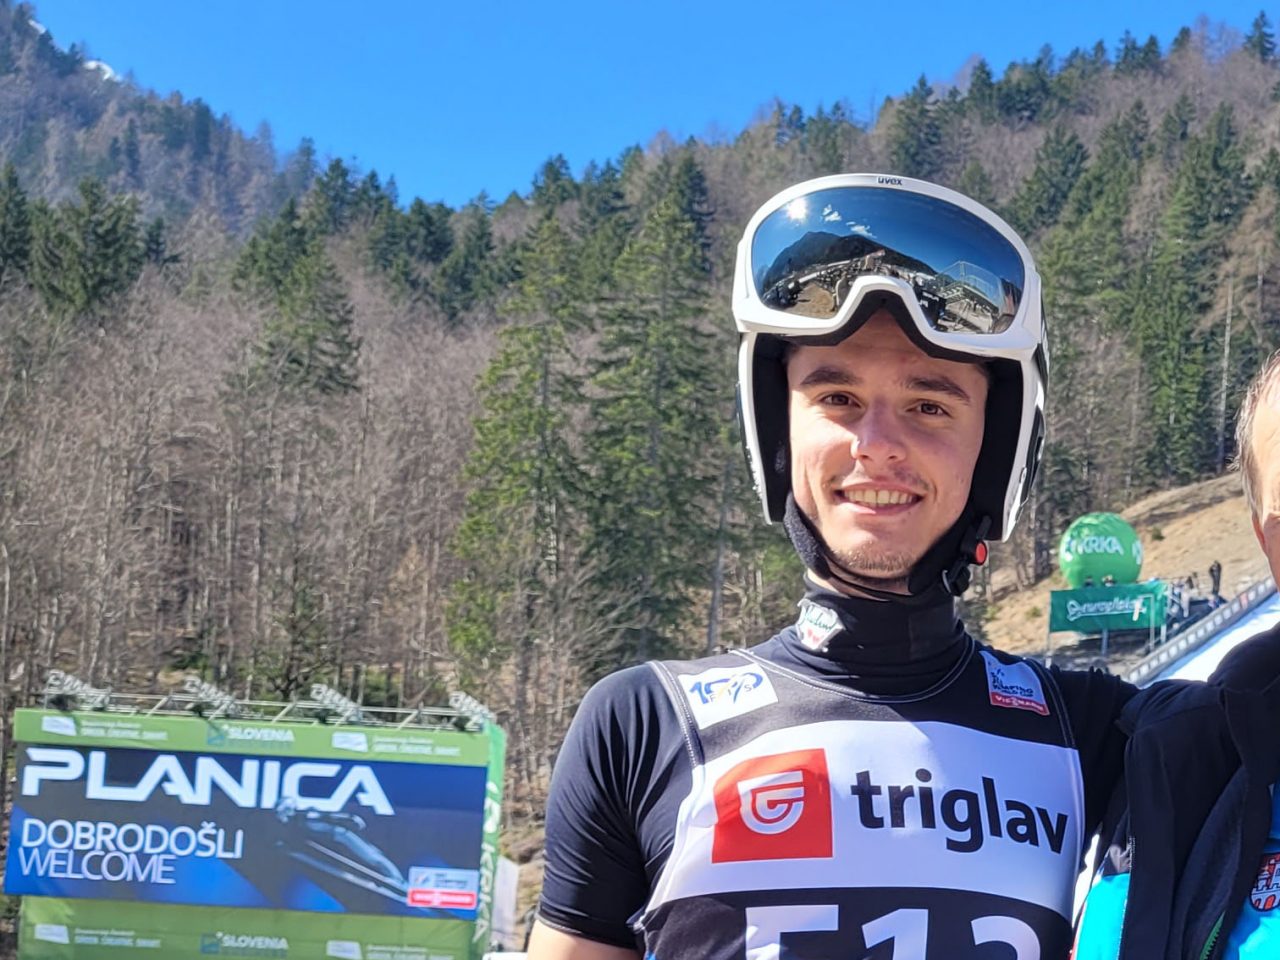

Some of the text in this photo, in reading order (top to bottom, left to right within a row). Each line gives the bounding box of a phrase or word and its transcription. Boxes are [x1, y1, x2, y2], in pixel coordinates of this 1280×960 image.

[877, 176, 903, 186] uvex
[228, 726, 295, 742] SLOVENIA
[21, 747, 396, 816] PLANICA
[850, 767, 1068, 855] triglav
[21, 818, 244, 859] DOBRODOŠLI
[18, 847, 177, 884] WELCOME
[222, 933, 290, 951] SLOVENIA
